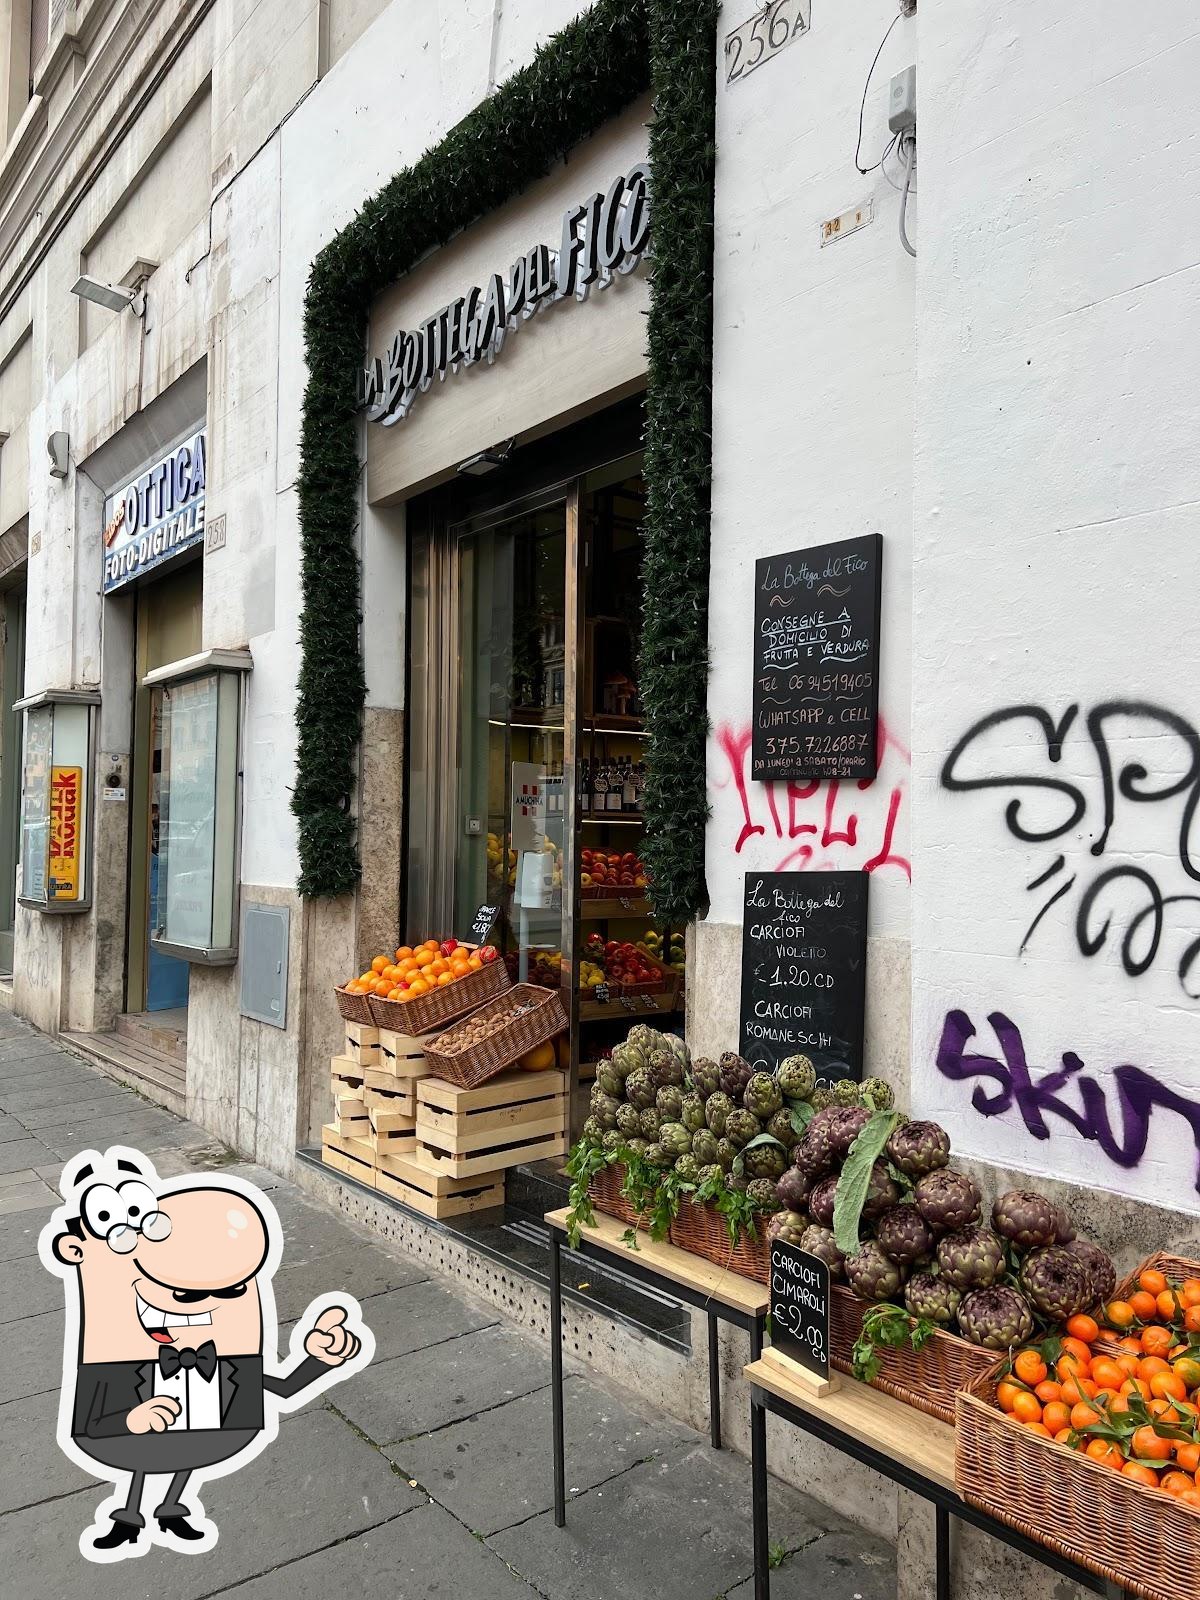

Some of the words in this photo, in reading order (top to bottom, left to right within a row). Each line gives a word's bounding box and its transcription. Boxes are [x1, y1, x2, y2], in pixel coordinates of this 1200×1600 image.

[367, 274, 506, 423] BOTTEGA
[508, 244, 557, 316] DEL
[559, 163, 651, 297] FICO
[124, 435, 206, 536] OTTICA
[761, 565, 780, 591] La
[784, 563, 820, 589] Bottega
[823, 557, 842, 577] del
[843, 554, 869, 575] Fico
[760, 611, 825, 634] CONSEGNE
[838, 606, 851, 620] A
[764, 648, 799, 663] FRUTTA
[807, 646, 813, 657] E
[821, 638, 869, 655] VERDURA
[769, 628, 828, 649] DOMICILIO
[841, 624, 852, 638] DI
[758, 676, 778, 692] Tel
[788, 674, 806, 690] 06
[758, 707, 824, 729] WHATSAPP
[827, 714, 836, 725] e
[840, 706, 871, 723] CELL
[49, 772, 76, 858] Kodak
[746, 879, 771, 908] La
[772, 888, 824, 918] Bottega
[824, 891, 844, 908] del
[750, 924, 805, 940] CARCIOFI
[775, 943, 827, 959] VIOLETTO
[754, 1000, 812, 1019] CARCIOFI
[745, 1021, 832, 1049] ROMANESCHI
[772, 1251, 821, 1289] CARCIOFI
[772, 1271, 825, 1317] CIMAROLI
[772, 1303, 823, 1349] €2.00
